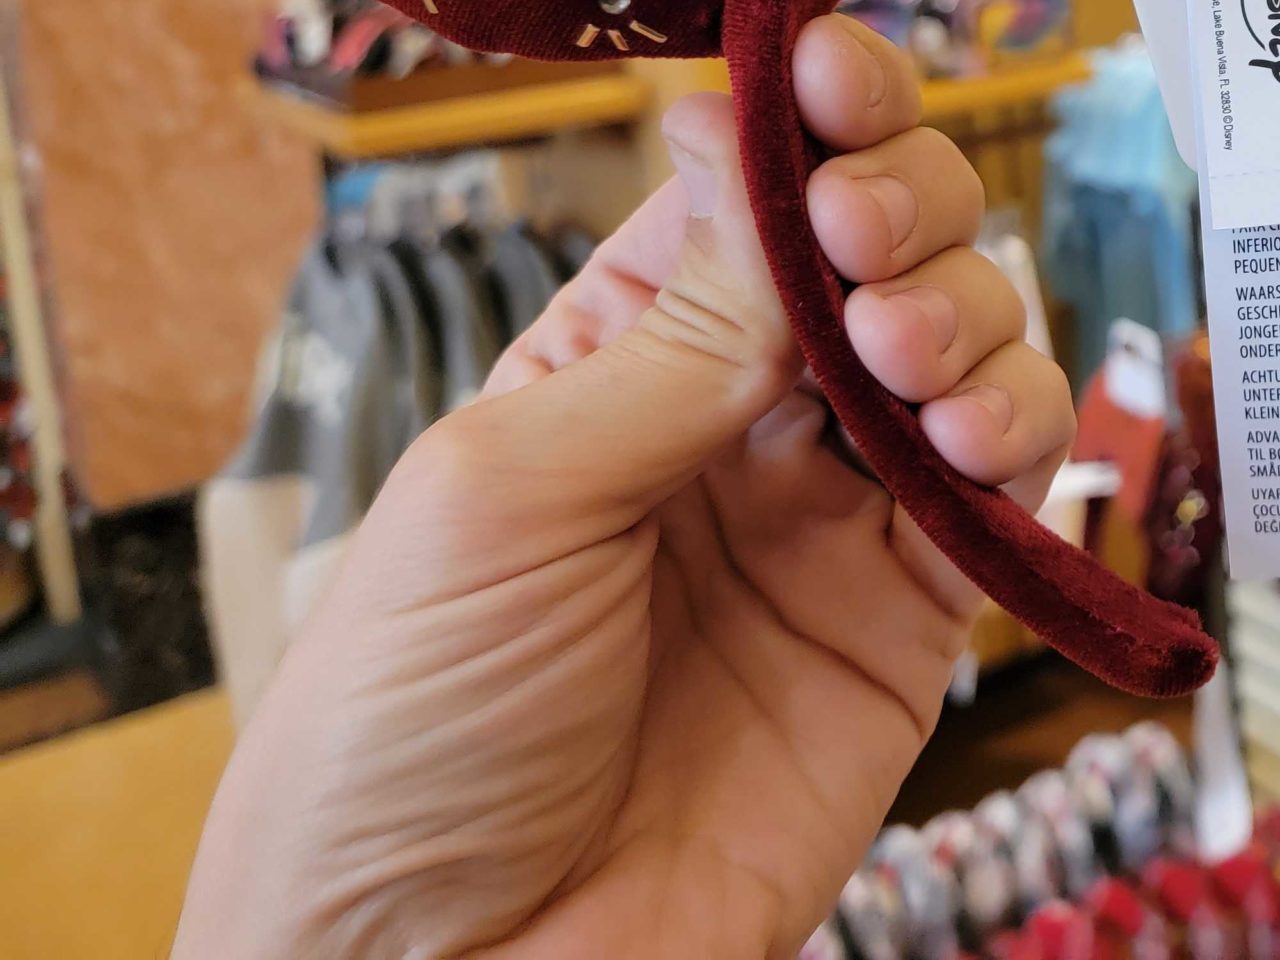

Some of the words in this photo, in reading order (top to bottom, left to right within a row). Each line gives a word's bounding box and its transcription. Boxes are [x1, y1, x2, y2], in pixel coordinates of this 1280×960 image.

[1213, 9, 1222, 29] Lake
[1215, 30, 1225, 55] Buena
[1219, 78, 1230, 89] FL
[1221, 90, 1232, 114] 32830
[1247, 447, 1266, 461] TIL
